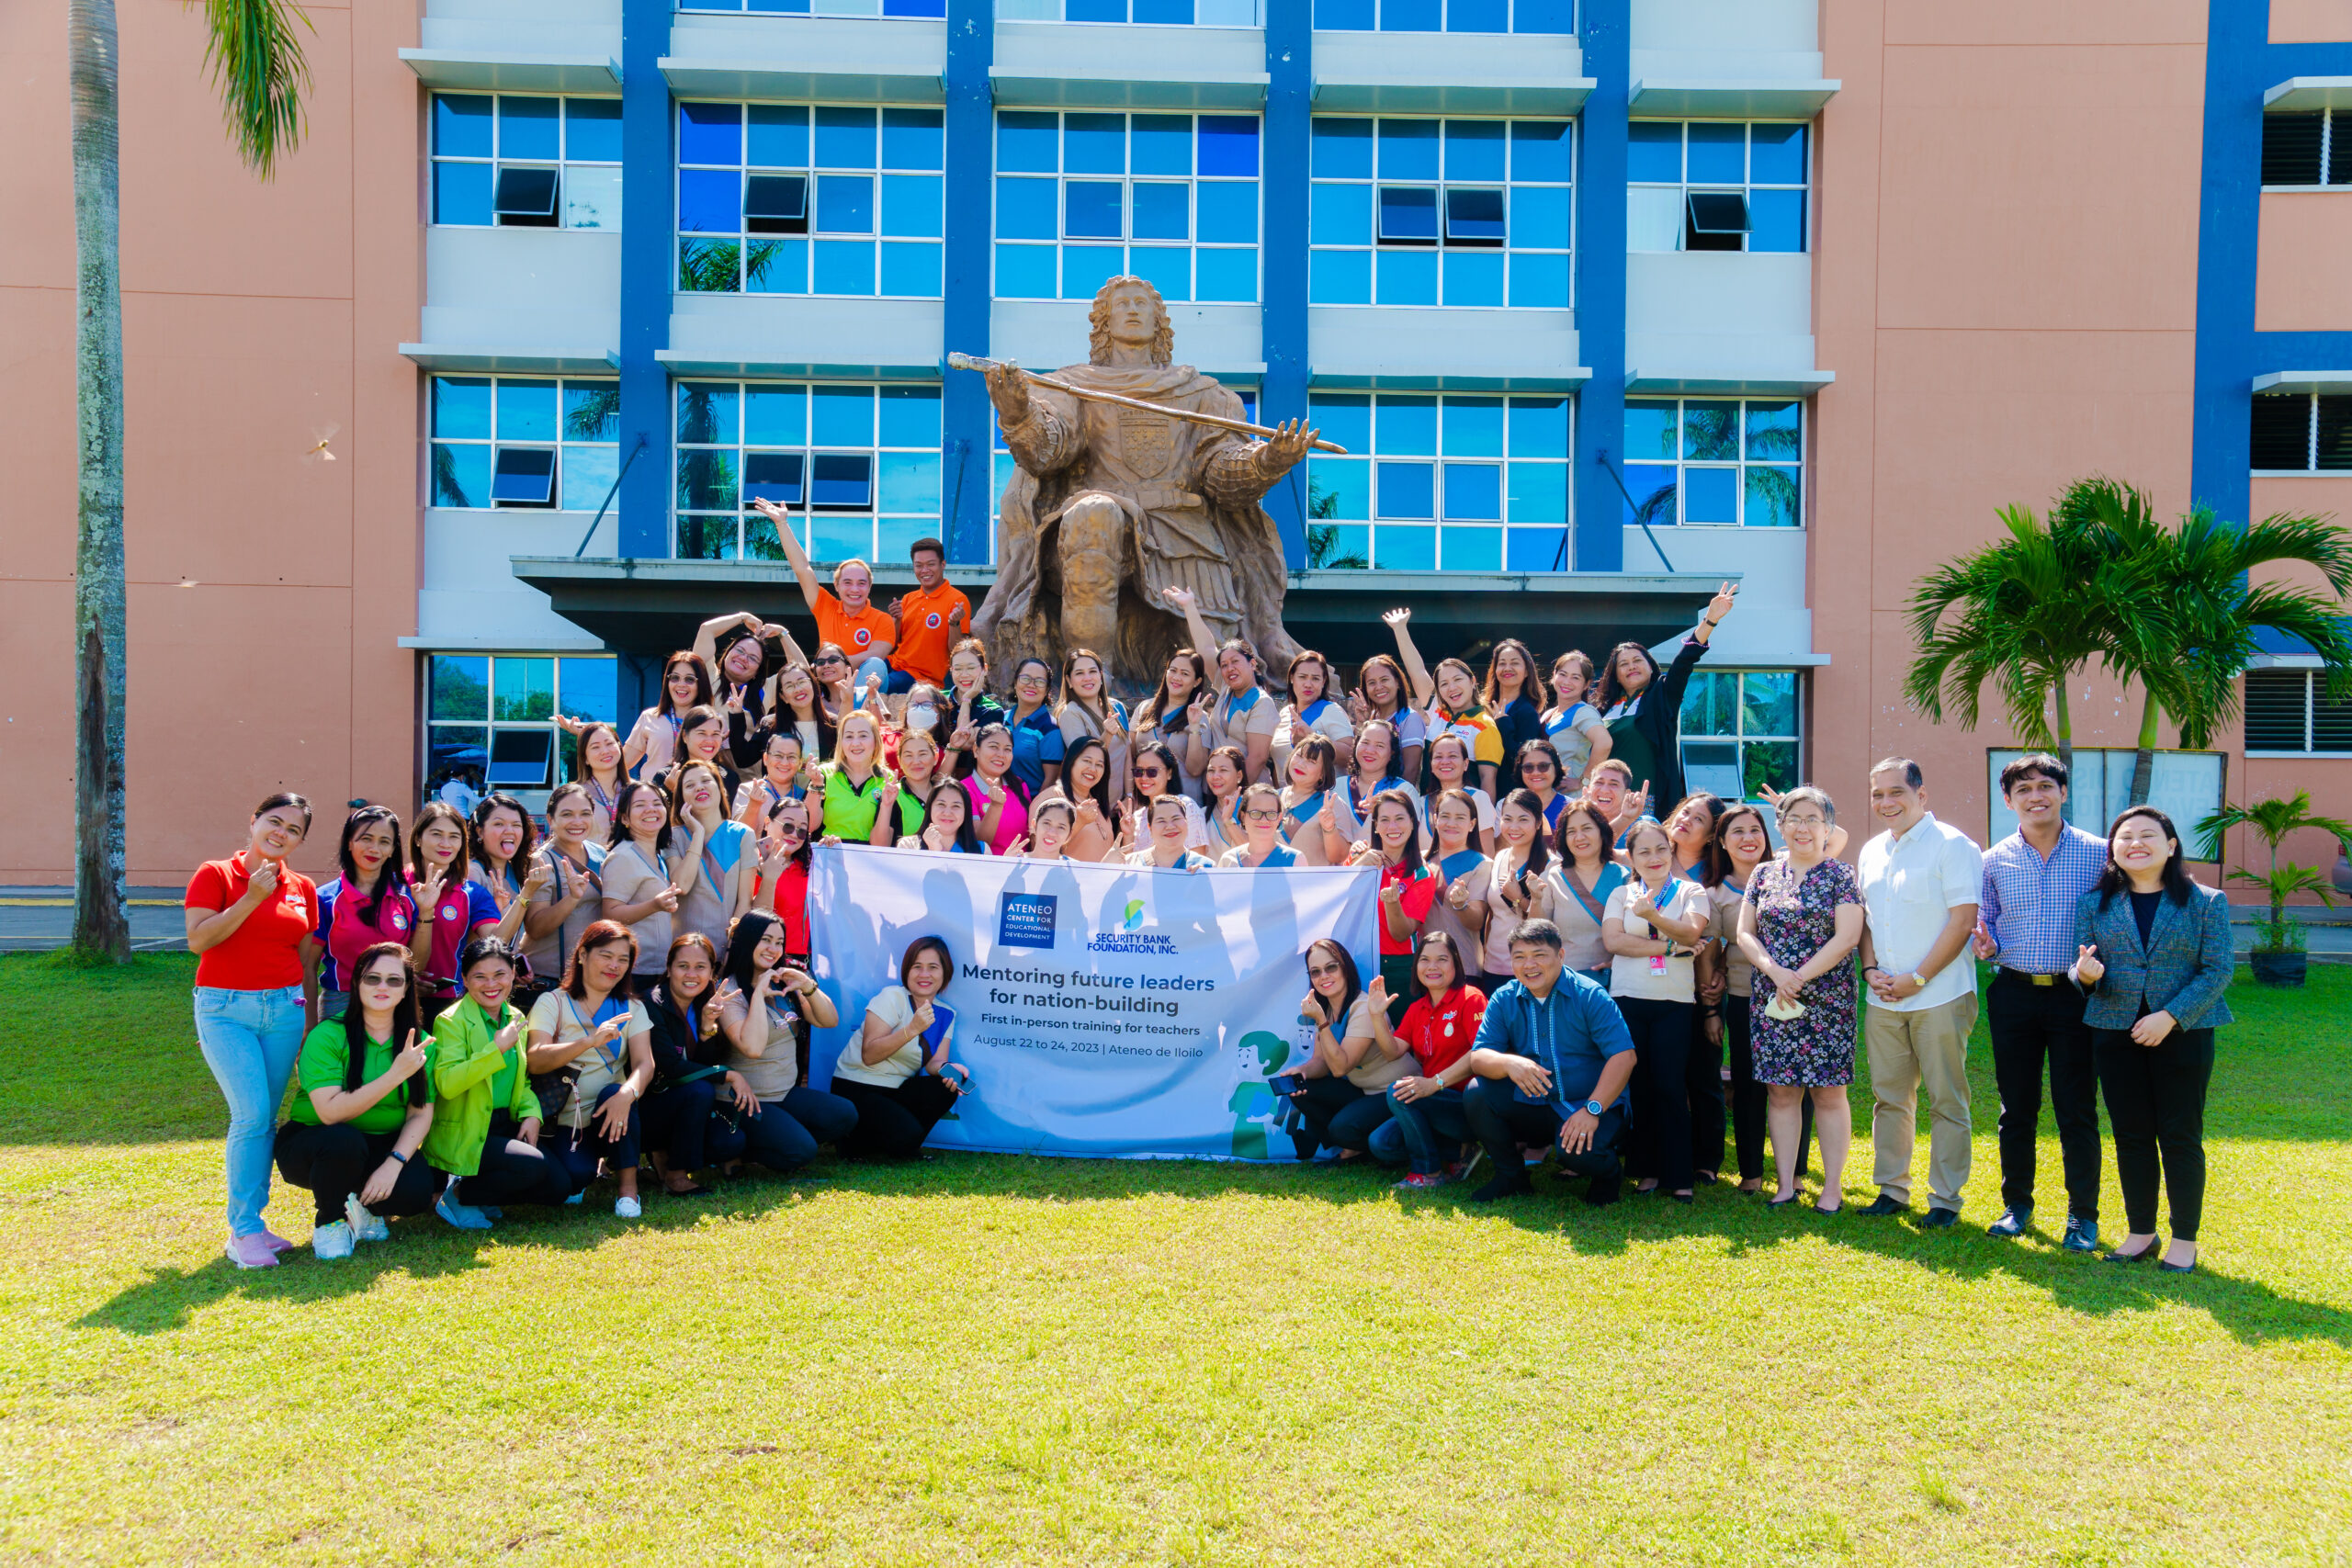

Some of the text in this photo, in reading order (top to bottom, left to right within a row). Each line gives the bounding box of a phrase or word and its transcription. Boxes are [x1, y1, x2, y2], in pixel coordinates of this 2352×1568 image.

[1007, 903, 1053, 915] ATENEO
[1006, 914, 1035, 923] CENTER
[1005, 923, 1051, 932] EDUCATIONAL
[1004, 931, 1050, 940] DEVELOPMENT
[1095, 933, 1171, 944] SECURITY BANK
[1087, 942, 1179, 955] FOUNDATION, INC.
[962, 964, 1215, 991] Mentoring future leaders
[989, 987, 1179, 1018] for nation-building
[981, 1013, 1201, 1035] First in-person training for teachers
[973, 1034, 1016, 1047] August
[1019, 1038, 1033, 1048] 22
[1035, 1040, 1048, 1049] to
[1050, 1040, 1069, 1053] 24,
[1070, 1042, 1100, 1054] 2023
[1108, 1044, 1153, 1056] Ateneo
[1155, 1046, 1171, 1057] de
[1174, 1047, 1204, 1058] Iloilo
